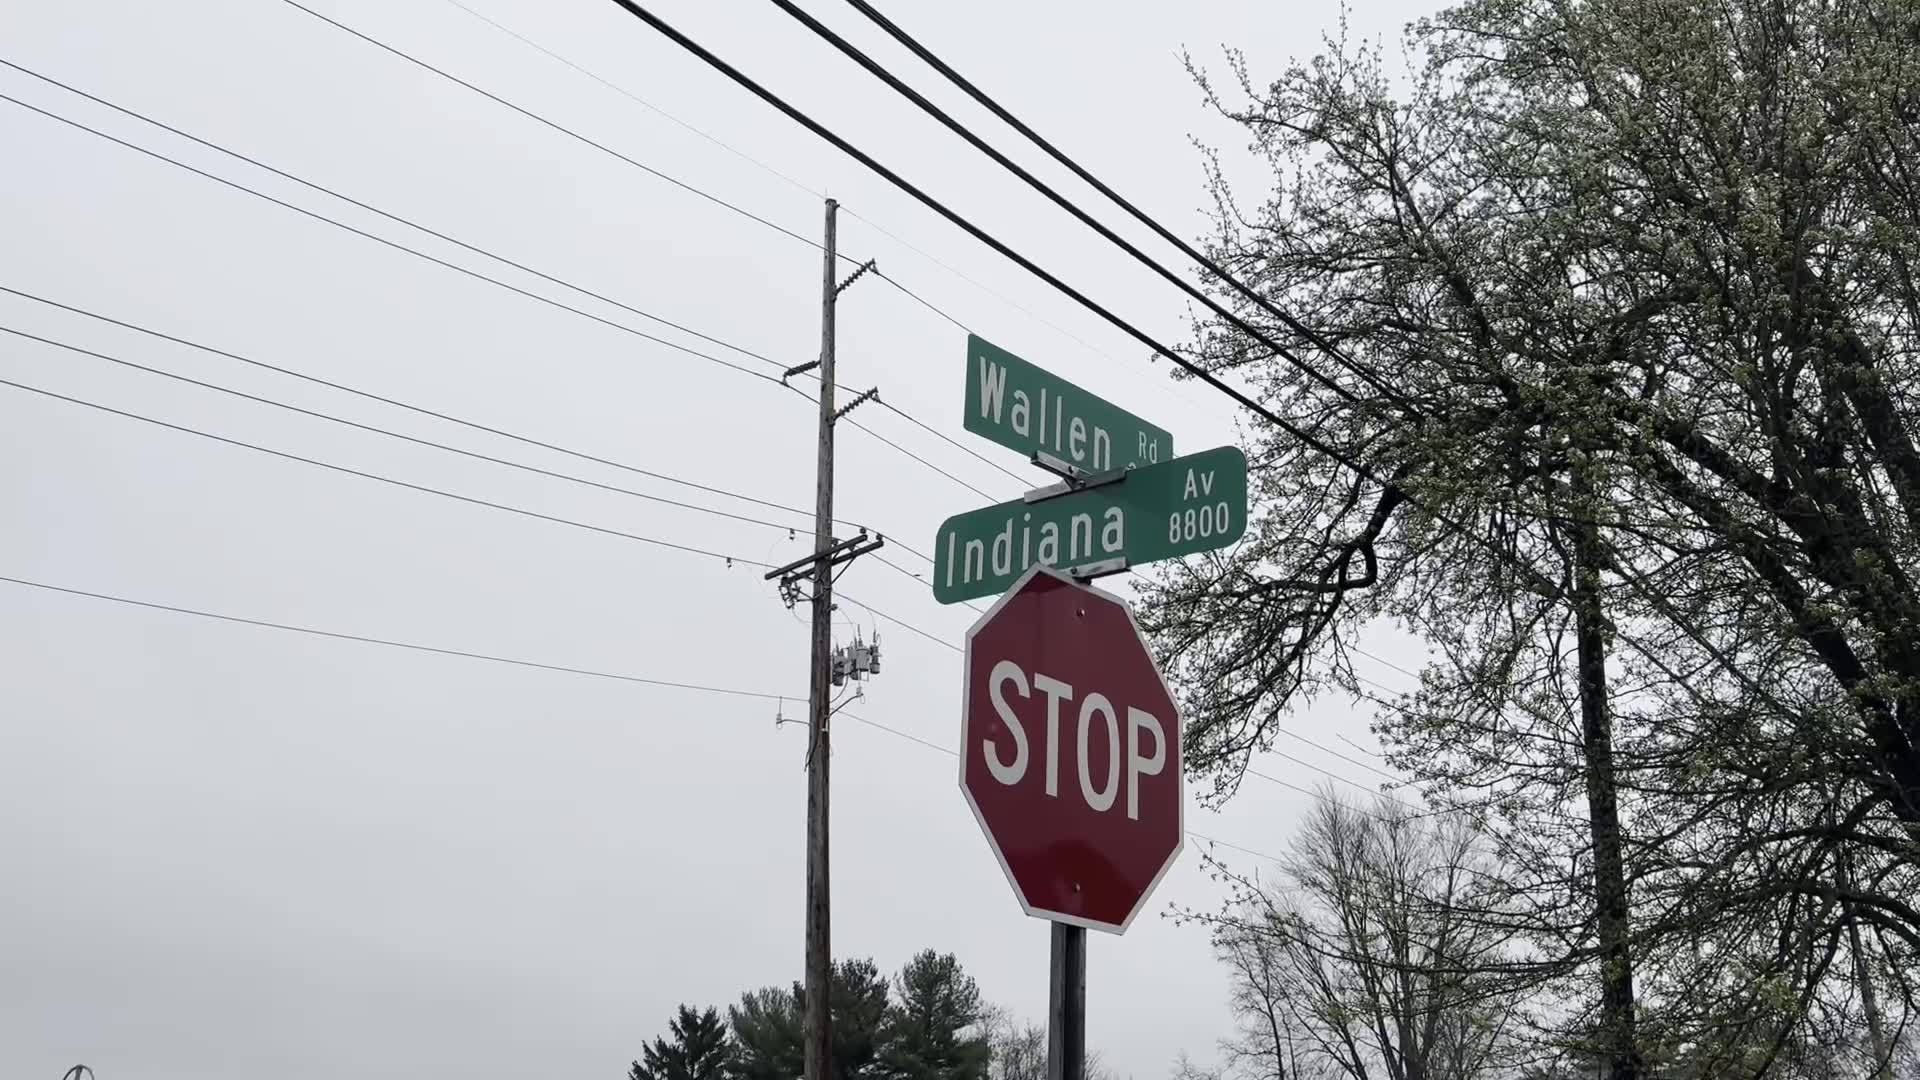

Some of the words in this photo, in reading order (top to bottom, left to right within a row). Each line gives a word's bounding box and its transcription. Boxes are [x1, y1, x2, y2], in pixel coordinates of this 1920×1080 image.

[979, 356, 1111, 471] Wallen
[1138, 431, 1158, 464] Rd
[946, 505, 1125, 588] Indiana
[1184, 468, 1215, 501] Av
[1168, 502, 1230, 545] 8800
[983, 660, 1167, 821] STOP
